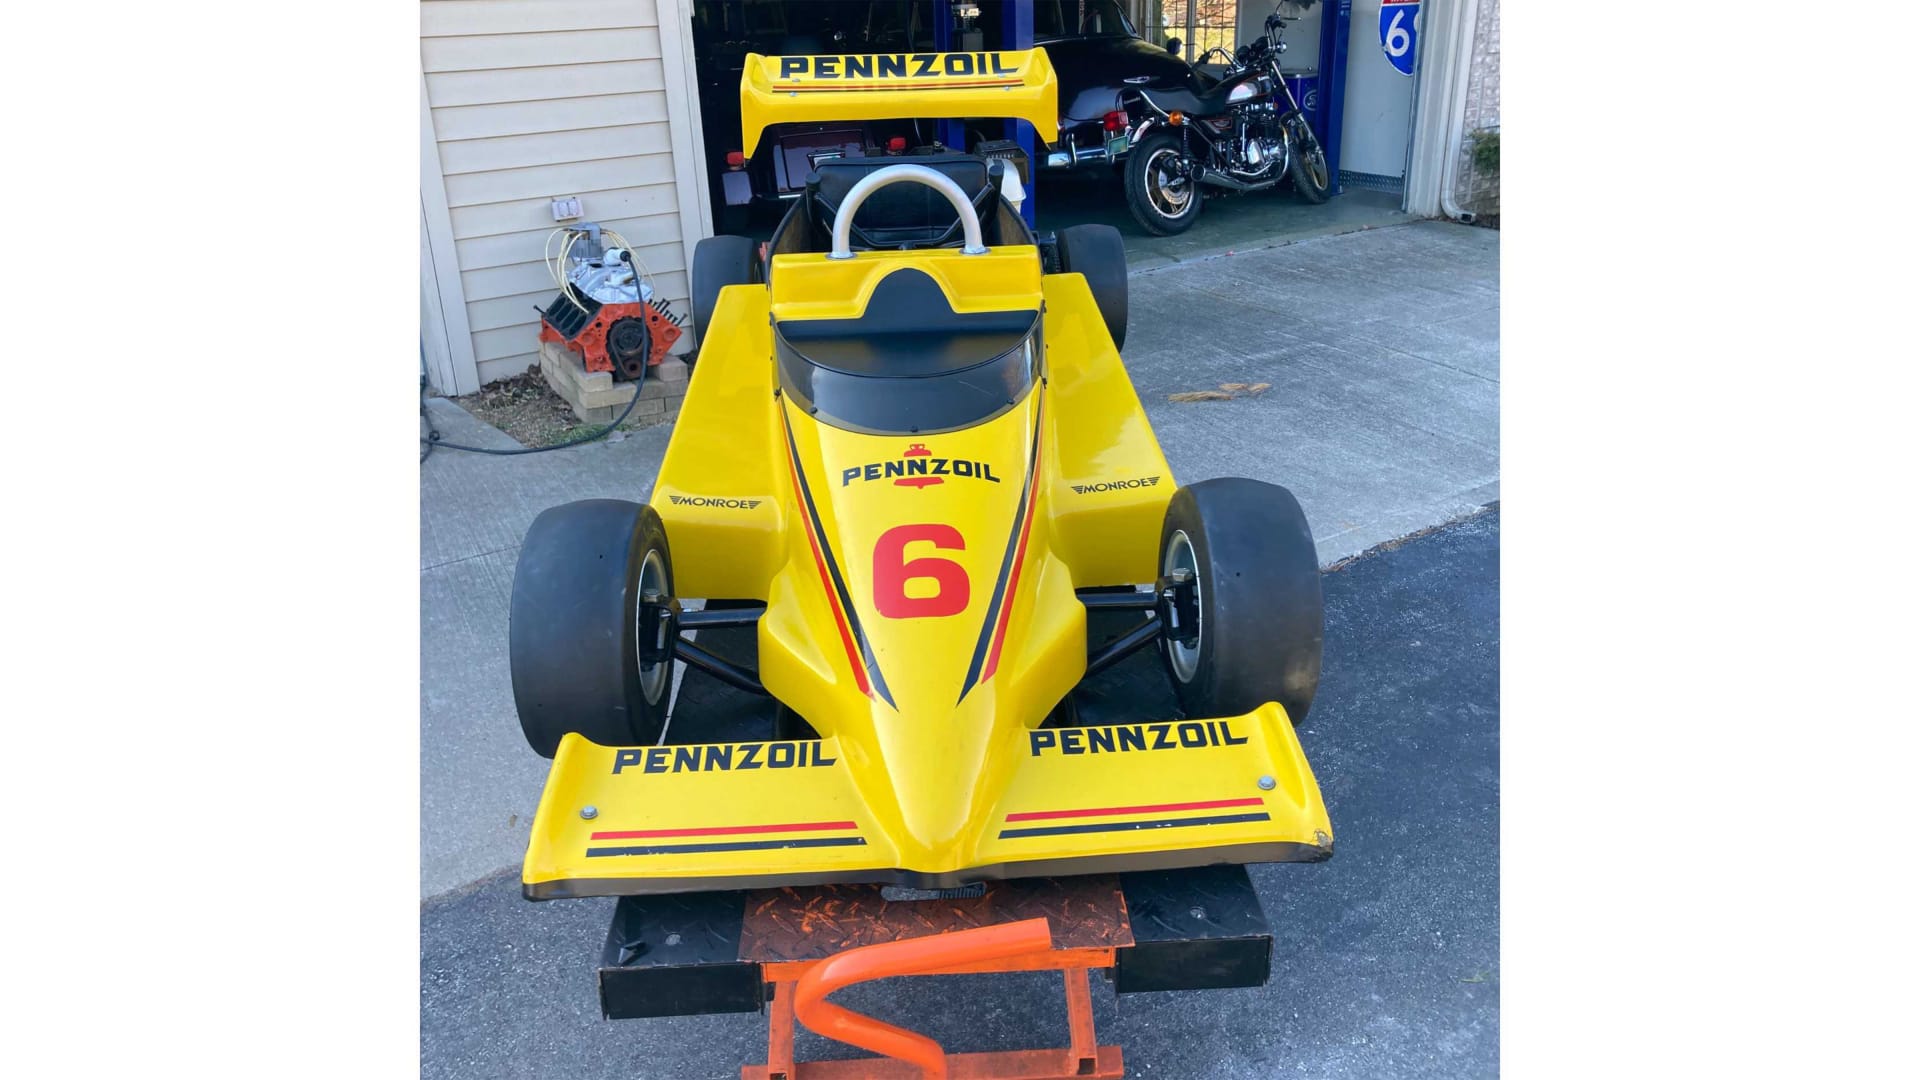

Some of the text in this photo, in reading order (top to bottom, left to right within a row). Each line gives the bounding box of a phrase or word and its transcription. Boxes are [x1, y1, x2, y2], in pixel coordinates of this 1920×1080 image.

[780, 53, 1018, 79] PENNZOIL
[842, 458, 1001, 487] PENNZOIL
[1083, 478, 1149, 494] MONROE
[679, 497, 749, 509] MONROE
[873, 523, 971, 619] 6
[1029, 720, 1249, 757] PENNZOIL
[612, 741, 837, 775] PENNZOIL
